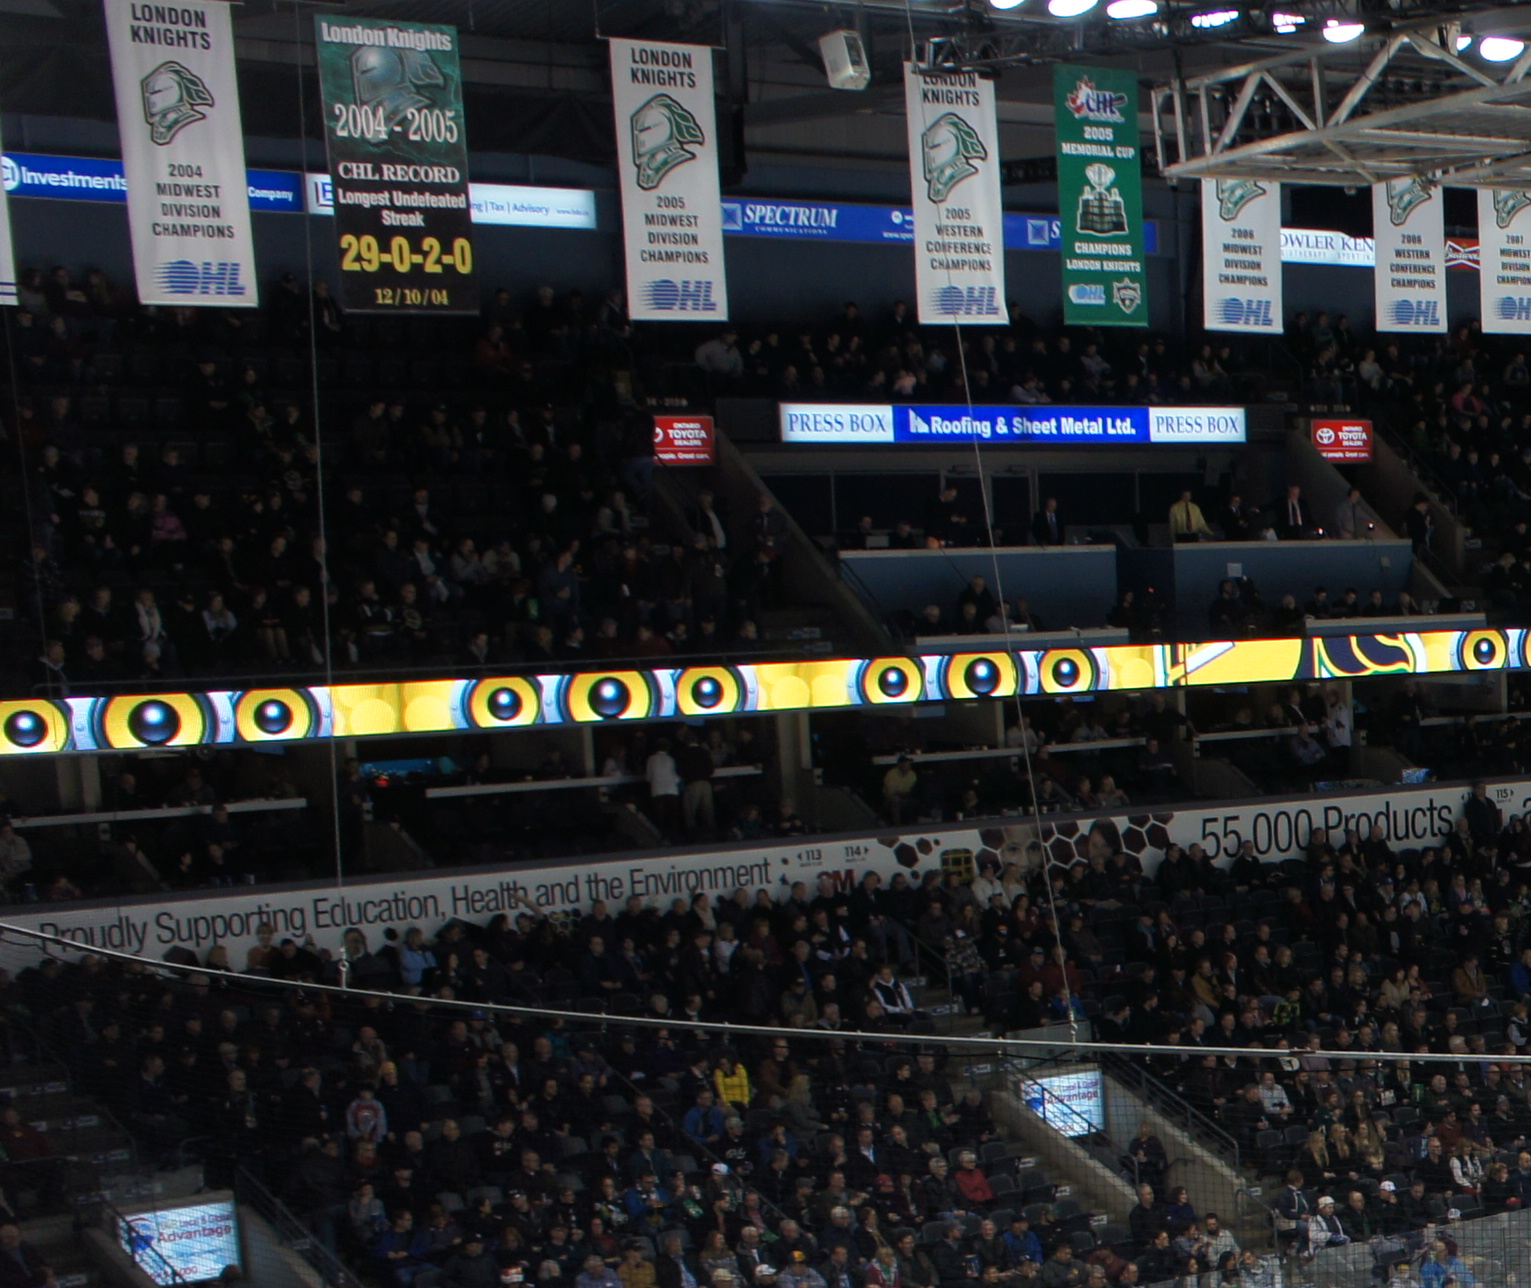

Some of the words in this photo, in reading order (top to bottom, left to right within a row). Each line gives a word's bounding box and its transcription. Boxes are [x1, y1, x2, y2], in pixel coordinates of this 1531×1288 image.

[131, 3, 206, 28] LONDON
[130, 24, 211, 50] KNIGHTS
[321, 22, 386, 46] London
[387, 27, 452, 51] Knights
[631, 47, 692, 69] LONDON
[630, 67, 696, 88] KNIGHTS
[922, 88, 980, 107] KNIGHTS
[334, 103, 388, 139] 2004
[406, 108, 459, 143] 2005
[1084, 126, 1114, 141] 2005
[1061, 142, 1114, 158] MEMORIAL
[1115, 146, 1136, 159] CUP
[21, 166, 128, 190] Investments
[168, 164, 203, 178] 2004
[338, 162, 380, 181] CHL
[382, 164, 460, 184] RECORD
[156, 183, 221, 199] MIDWEST
[248, 187, 293, 201] Company
[337, 188, 390, 208] Longest
[392, 190, 467, 209] Undefeated
[512, 203, 550, 216] Advisory
[657, 196, 685, 209] 2005
[161, 203, 221, 219] DIVISION
[744, 204, 838, 229] SPECTRUM
[382, 211, 425, 228] Streak
[644, 213, 699, 228] MIDWEST
[152, 223, 235, 239] CHAMPIONS
[647, 232, 699, 246] DIVISION
[935, 224, 984, 238] WESTERN
[340, 234, 473, 275] 29-0-2-0
[926, 241, 992, 255] CONFERENCE
[1222, 242, 1263, 256] MIDWEST
[1394, 248, 1431, 260] WESTERN
[640, 250, 709, 264] CHAMPIONS
[931, 258, 993, 272] CHAMPIONS
[1224, 258, 1262, 271] DIVISION
[1390, 262, 1436, 275] CONFERENCE
[152, 260, 246, 296] OHL
[639, 279, 717, 311] OHL
[788, 413, 845, 434] PRESS
[850, 413, 887, 434] BOX
[931, 415, 992, 438] Roofing
[998, 415, 1008, 433] &
[1013, 415, 1057, 435] Sheet
[1062, 415, 1102, 435] Metal
[1108, 415, 1136, 435] Ltd.
[1155, 414, 1203, 434] PRESS
[1208, 414, 1240, 434] BOX
[667, 429, 708, 439] TOYOTA
[1338, 432, 1367, 440] TOYOTA
[1325, 798, 1453, 845] Products
[805, 849, 822, 861] 113
[845, 846, 861, 858] 114
[40, 914, 148, 956] Proudly
[156, 902, 306, 949] Supporting
[315, 884, 446, 930] Education,
[452, 878, 527, 917] Health
[536, 875, 582, 908] and
[586, 870, 619, 901] the
[629, 856, 772, 902] Environment
[158, 1224, 232, 1243] Advantage
